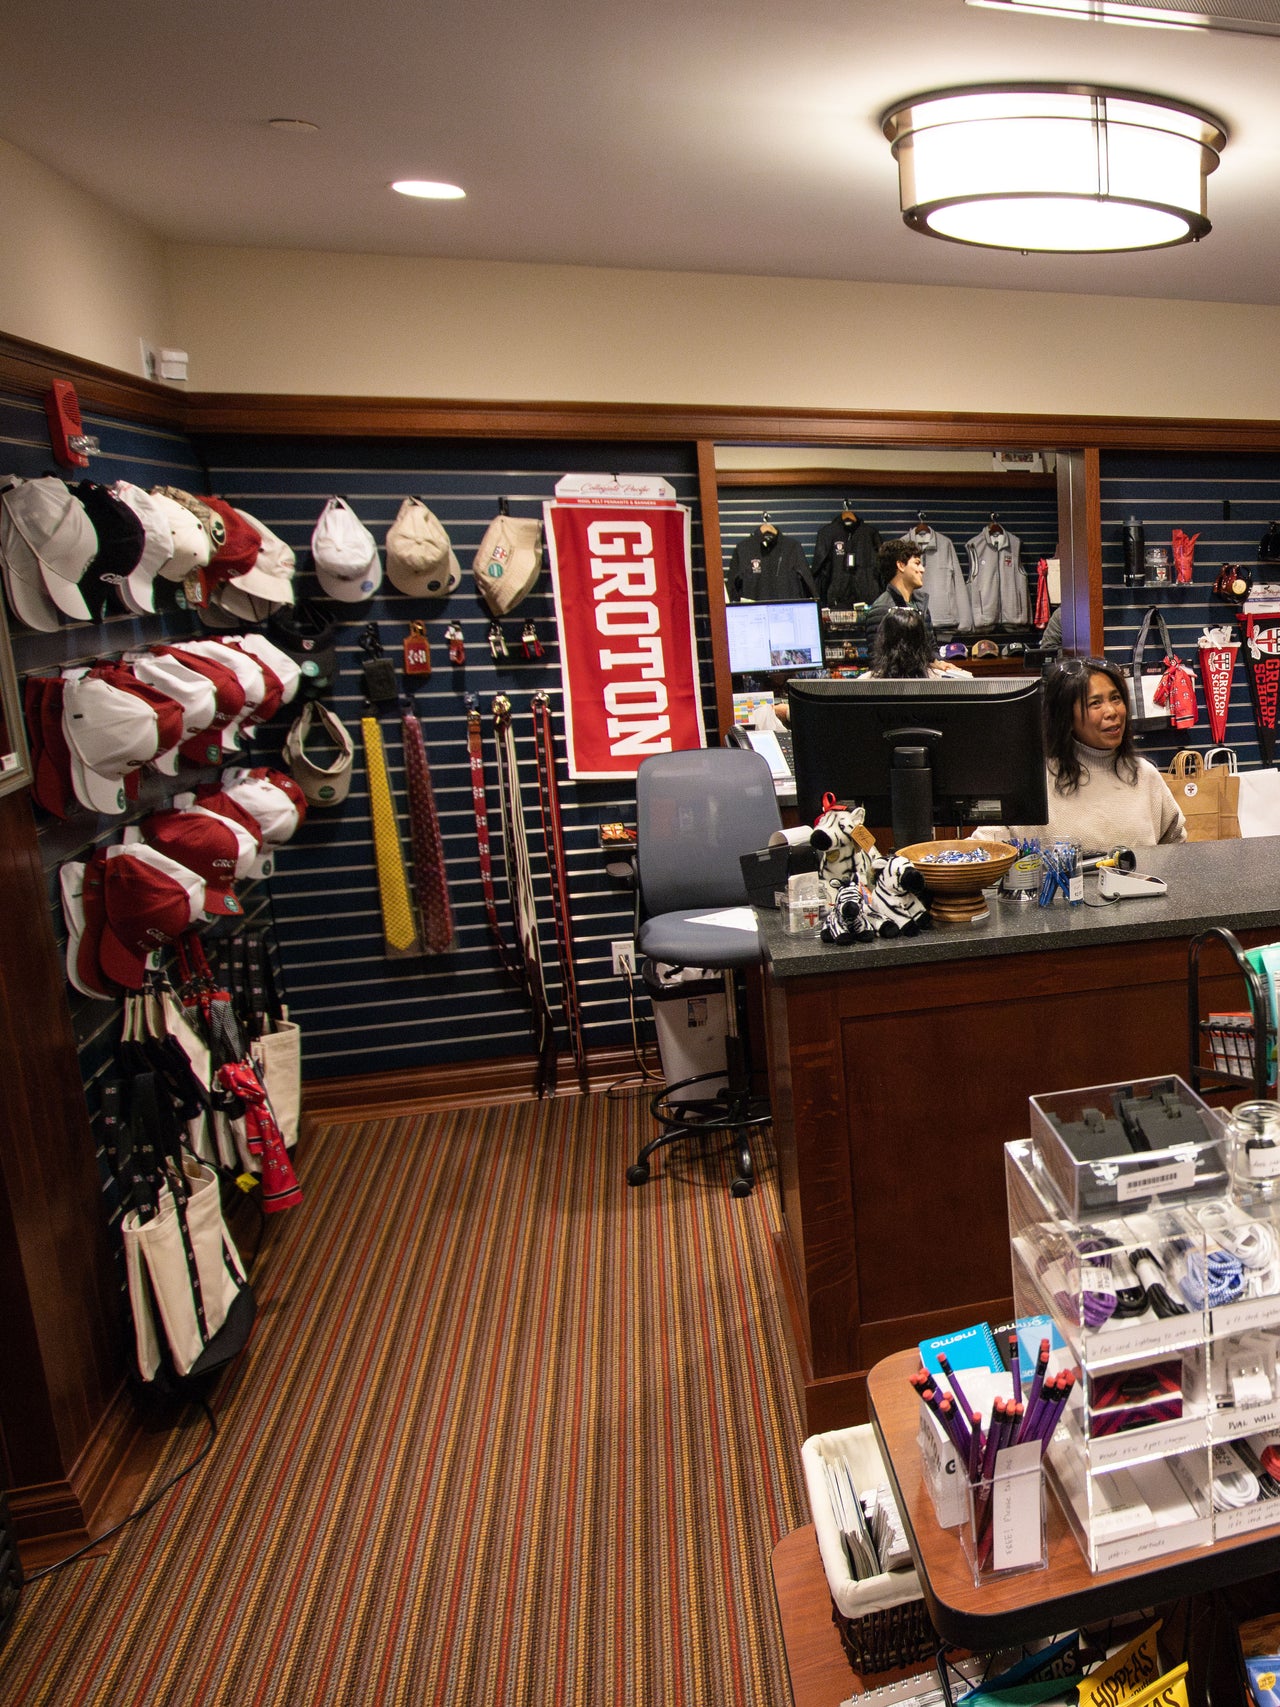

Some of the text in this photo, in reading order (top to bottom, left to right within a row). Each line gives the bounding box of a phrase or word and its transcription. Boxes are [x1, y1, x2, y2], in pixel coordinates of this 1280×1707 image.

[586, 520, 673, 758] GROTON
[1211, 673, 1221, 717] SCHOOL
[1217, 671, 1230, 717] GROTON
[1253, 663, 1271, 727] SCHOOL
[1265, 658, 1280, 730] GROTON
[930, 1329, 977, 1349] memo
[1254, 1413, 1277, 1424] WALL
[1090, 1640, 1155, 1707] HIPPEAS
